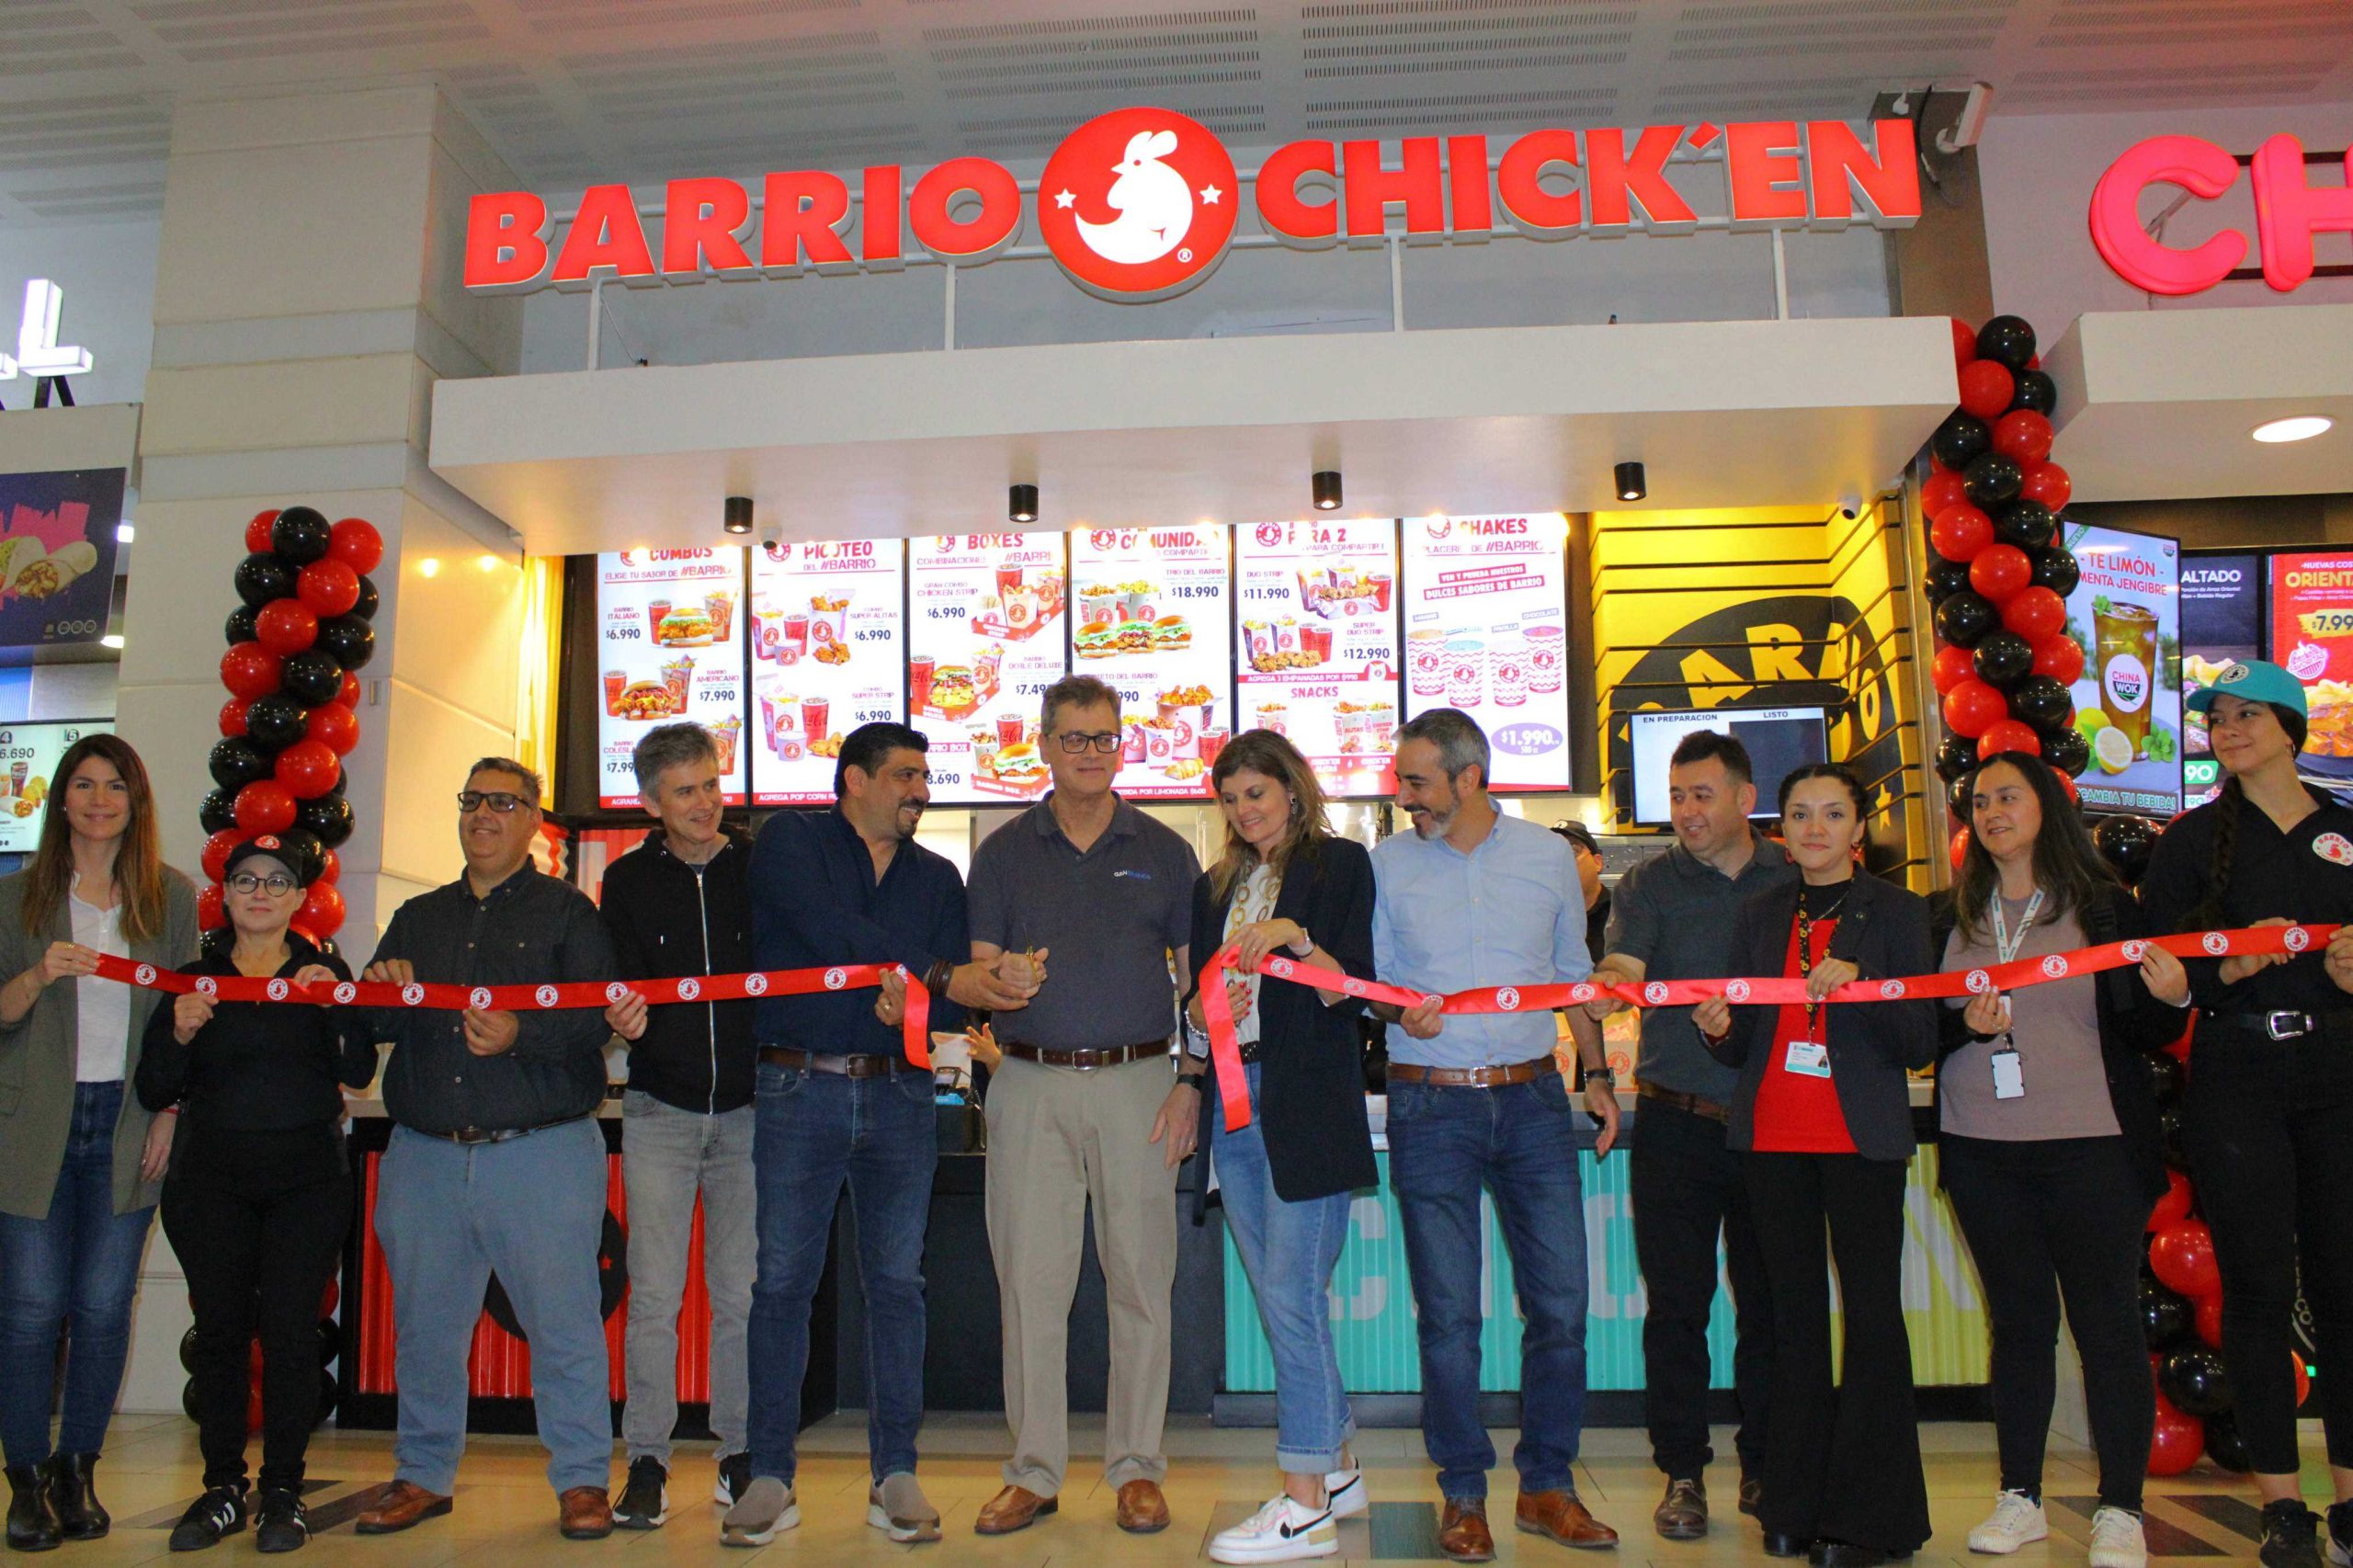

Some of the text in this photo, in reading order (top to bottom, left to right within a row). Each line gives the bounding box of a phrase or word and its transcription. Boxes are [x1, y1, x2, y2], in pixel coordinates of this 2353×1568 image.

[464, 119, 1922, 296] BARRIO CHICK'EN
[0, 279, 93, 378] L
[1337, 528, 1347, 542] 2
[967, 533, 1024, 550] BOXES
[1423, 545, 1461, 553] LACERE
[1471, 544, 1483, 552] DE
[1005, 551, 1051, 562] #BARRI
[2088, 551, 2155, 577] TE LIMÓN
[2180, 569, 2242, 584] ALTADO
[2285, 571, 2353, 588] ORIENT
[1426, 576, 1542, 599] DULCES SABORES DE BARRIO
[2079, 572, 2167, 597] MENTA JENGIBRE
[1172, 585, 1219, 598] $18.990
[1244, 587, 1290, 599] $11.990
[927, 607, 965, 619] $6.990
[2312, 614, 2353, 631] $7.99
[606, 629, 641, 640] $6.990
[855, 630, 892, 641] $6.990
[1344, 648, 1390, 660] $12.990
[696, 675, 740, 683] AMERICANO
[1618, 622, 1881, 741] ARRIO
[2112, 670, 2141, 683] CHINA
[1016, 684, 1048, 695] $7.49
[1290, 686, 1338, 699] SNACKS
[2115, 682, 2139, 694] WOK
[699, 690, 735, 701] $7.990
[1118, 691, 1139, 702] 990
[855, 710, 892, 722] $6.990
[1656, 713, 1718, 722] PREPARACION
[1762, 710, 1789, 719] LISTO
[1501, 730, 1552, 745] $1.990
[949, 743, 969, 752] BOX
[607, 762, 634, 773] $7.99
[2184, 764, 2213, 781] 90
[926, 773, 960, 785] 8.690
[2078, 787, 2177, 810] CAMBIA TU BEBIDA!
